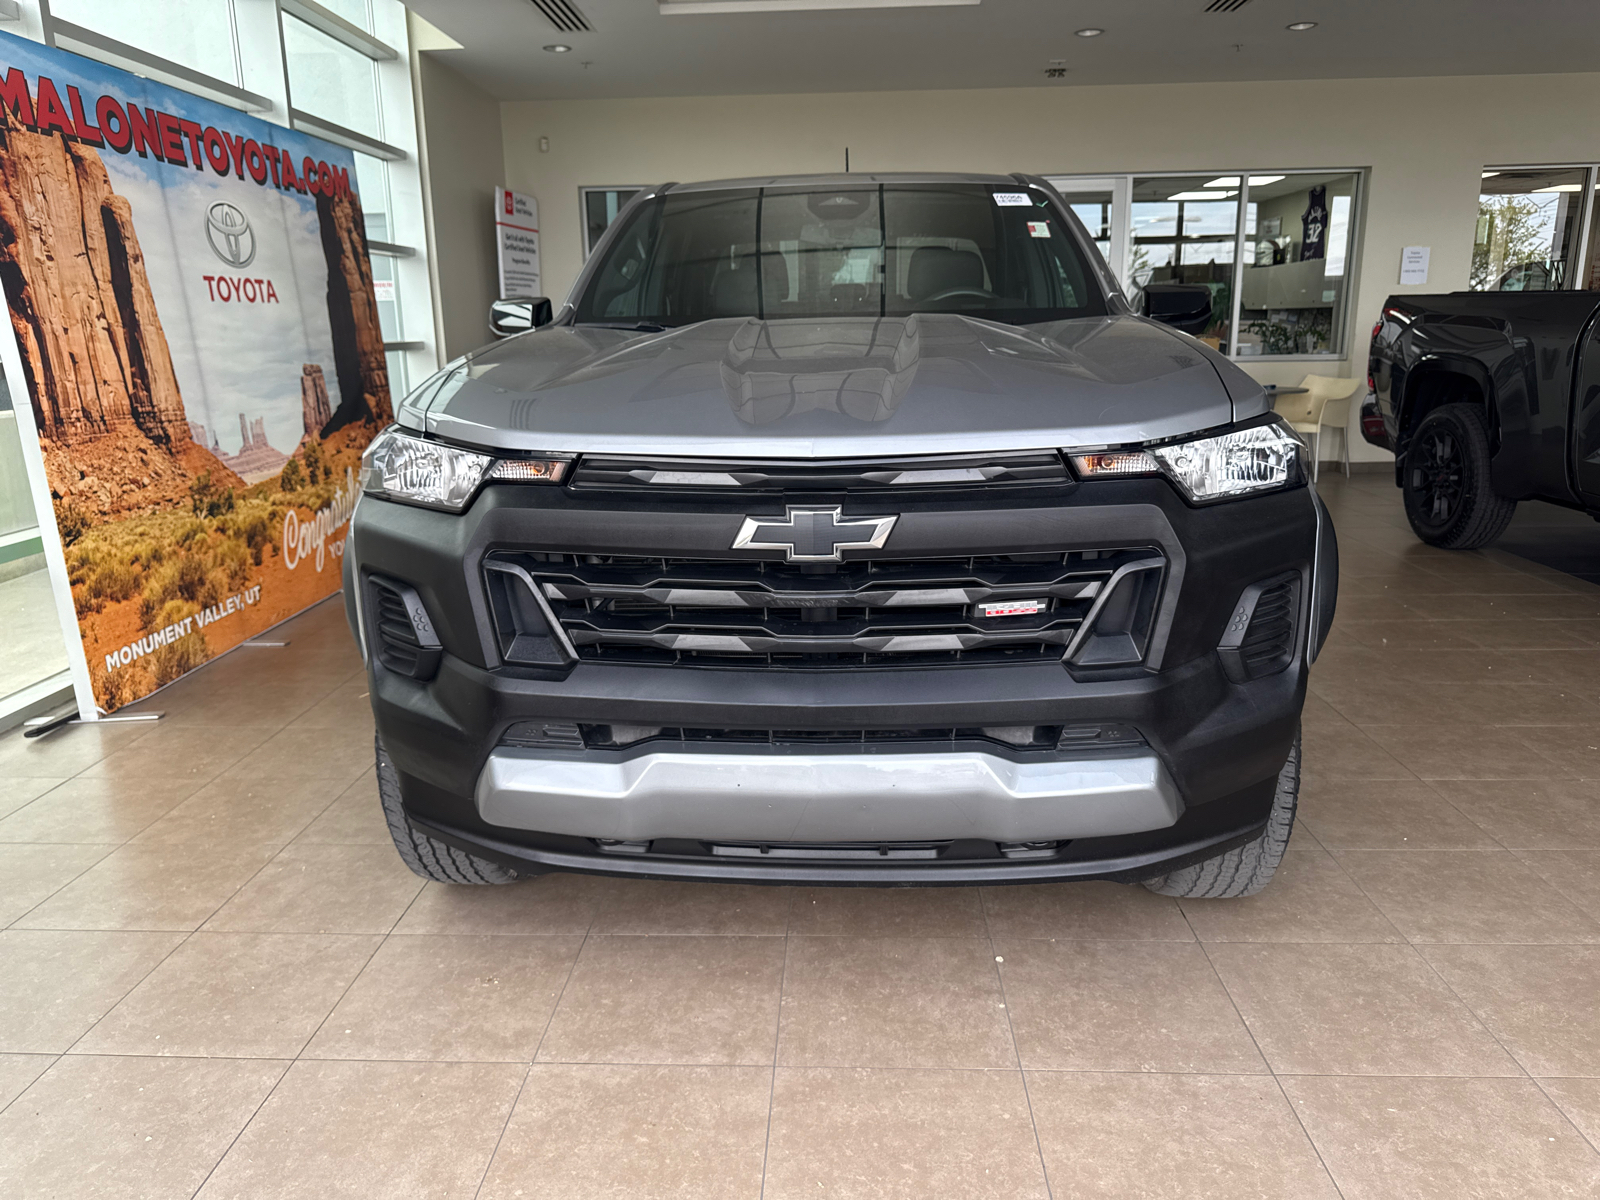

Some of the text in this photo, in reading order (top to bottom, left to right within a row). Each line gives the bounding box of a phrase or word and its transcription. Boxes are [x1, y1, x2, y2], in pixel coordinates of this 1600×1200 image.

[1305, 222, 1322, 243] 32
[203, 275, 279, 303] TOYOTA
[105, 585, 261, 673] MONUMENT VALLEY, UT
